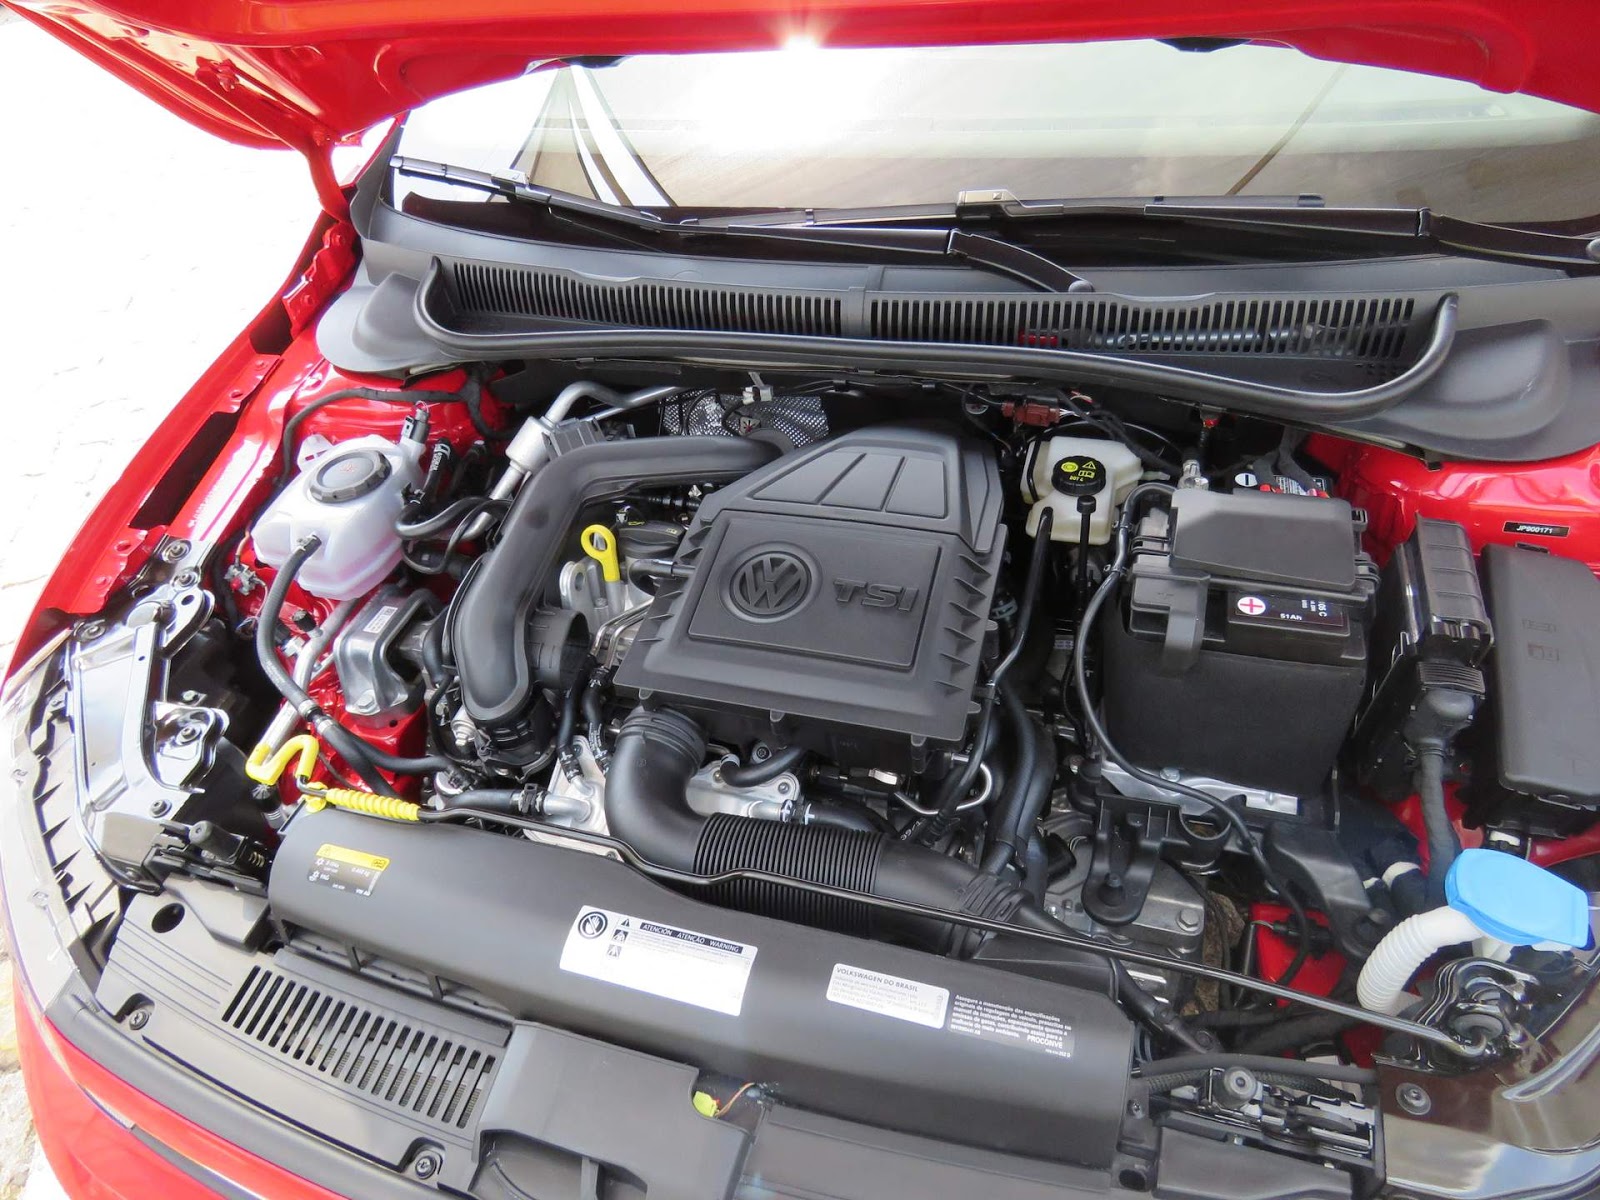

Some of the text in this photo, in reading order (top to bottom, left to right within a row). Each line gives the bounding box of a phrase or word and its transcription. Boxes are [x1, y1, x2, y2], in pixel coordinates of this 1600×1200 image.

[1516, 525, 1553, 534] JP900171
[834, 577, 919, 612] TSI
[1280, 613, 1302, 621] 51Ah
[643, 923, 672, 936] ATENCIÓN
[676, 931, 705, 944] ATENÇÃO
[709, 940, 739, 952] WARNING
[836, 966, 882, 983] VOLKSWAGEN
[883, 978, 894, 986] DO
[895, 981, 918, 992] BRASIL
[1026, 1034, 1063, 1048] PROCONVE
